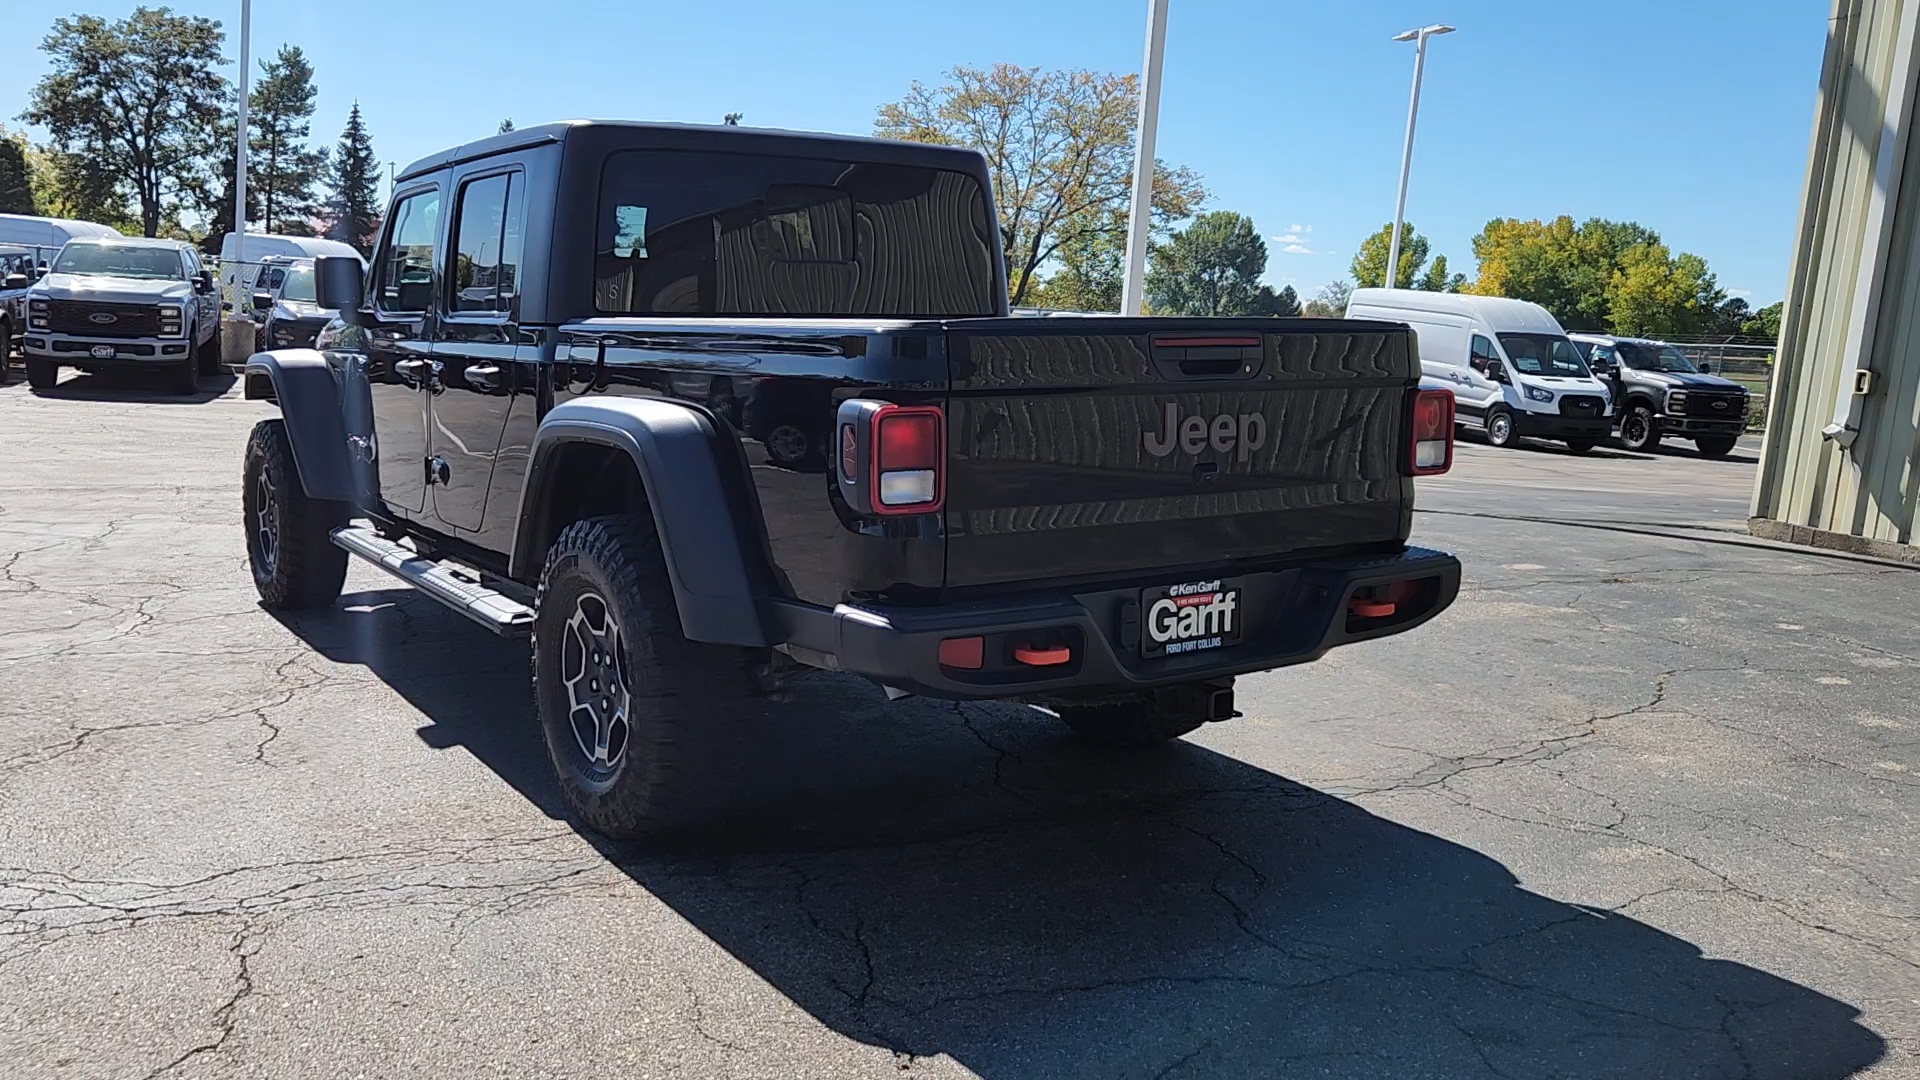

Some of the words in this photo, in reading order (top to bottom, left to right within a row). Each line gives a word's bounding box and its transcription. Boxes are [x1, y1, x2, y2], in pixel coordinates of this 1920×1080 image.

[1143, 402, 1266, 462] Jeep
[1178, 583, 1197, 595] Ken
[1197, 579, 1220, 592] Garff
[1148, 591, 1236, 642] Garff
[1166, 643, 1181, 654] FORD
[1182, 640, 1197, 652] FORT
[1197, 637, 1221, 649] COLLINS
